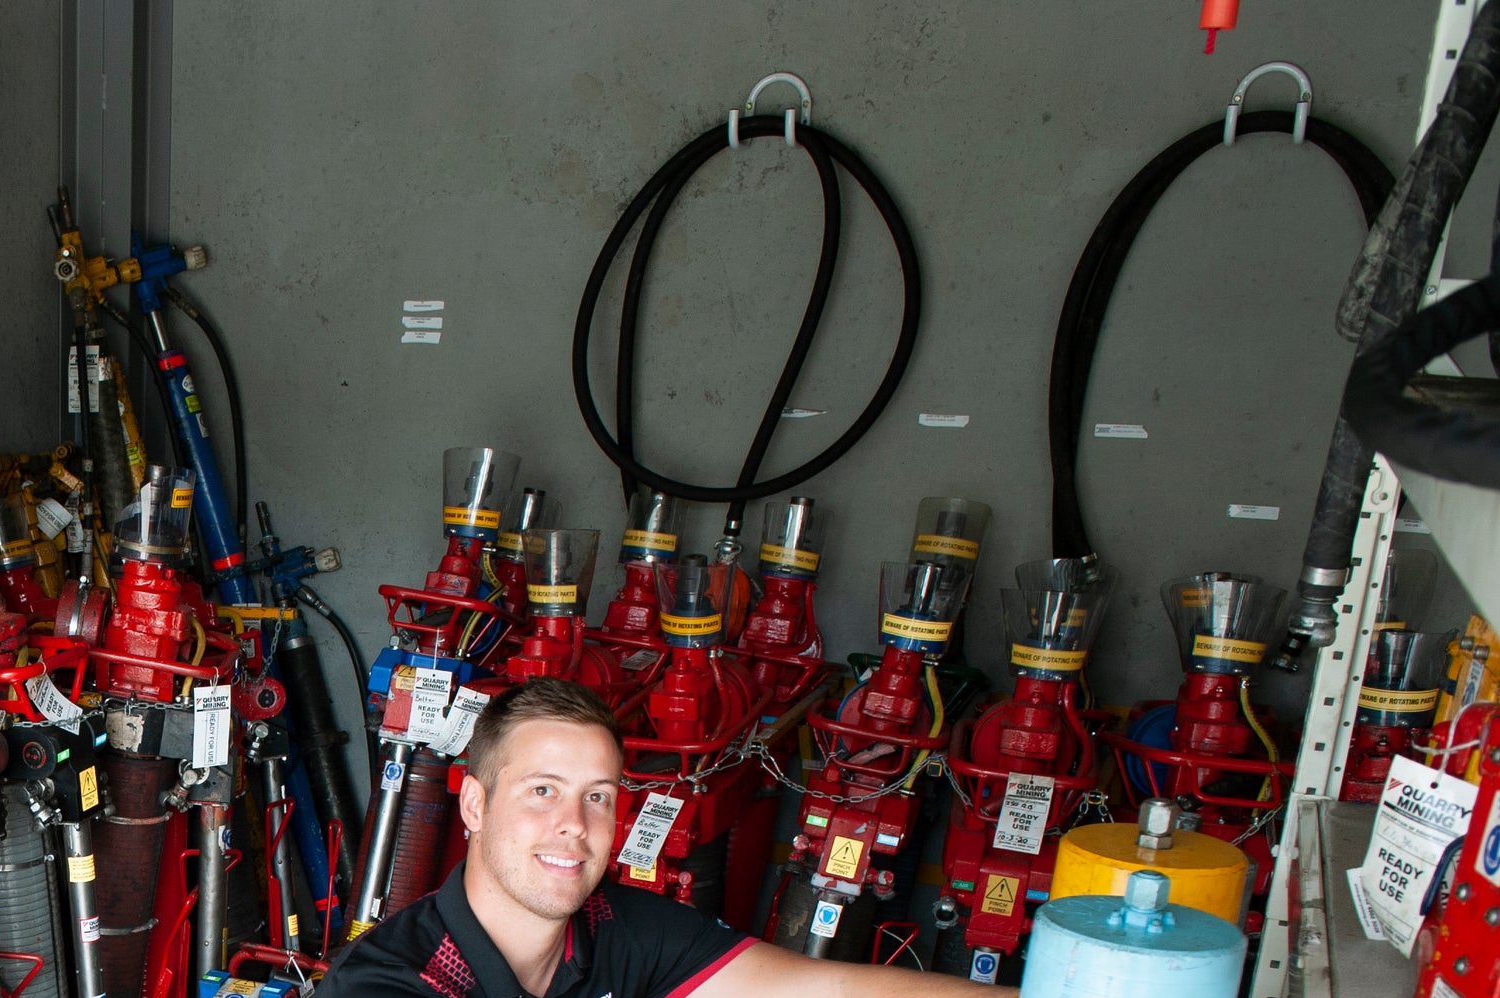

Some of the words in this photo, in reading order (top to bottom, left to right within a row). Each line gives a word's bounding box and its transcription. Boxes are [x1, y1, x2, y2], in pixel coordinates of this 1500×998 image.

[703, 620, 719, 629] PARTS
[1196, 643, 1220, 652] BEWARE
[1222, 645, 1231, 653] OF
[1042, 656, 1071, 665] ROTATING
[422, 677, 449, 686] QUARRY
[202, 695, 229, 703] QUARRY
[418, 705, 440, 713] READY
[1017, 783, 1052, 793] QUARRY
[1016, 789, 1046, 798] MINING
[1401, 785, 1473, 819] QUARRY
[650, 808, 673, 817] MINING
[652, 803, 678, 813] QUARRY
[1397, 797, 1455, 828] MINING
[1009, 811, 1039, 820] READY
[638, 829, 660, 839] READY
[637, 842, 651, 850] USE
[1378, 848, 1424, 880] READY
[832, 868, 849, 876] POINT
[1382, 866, 1409, 890] FOR
[1379, 879, 1405, 903] USE
[988, 906, 1006, 914] POINT
